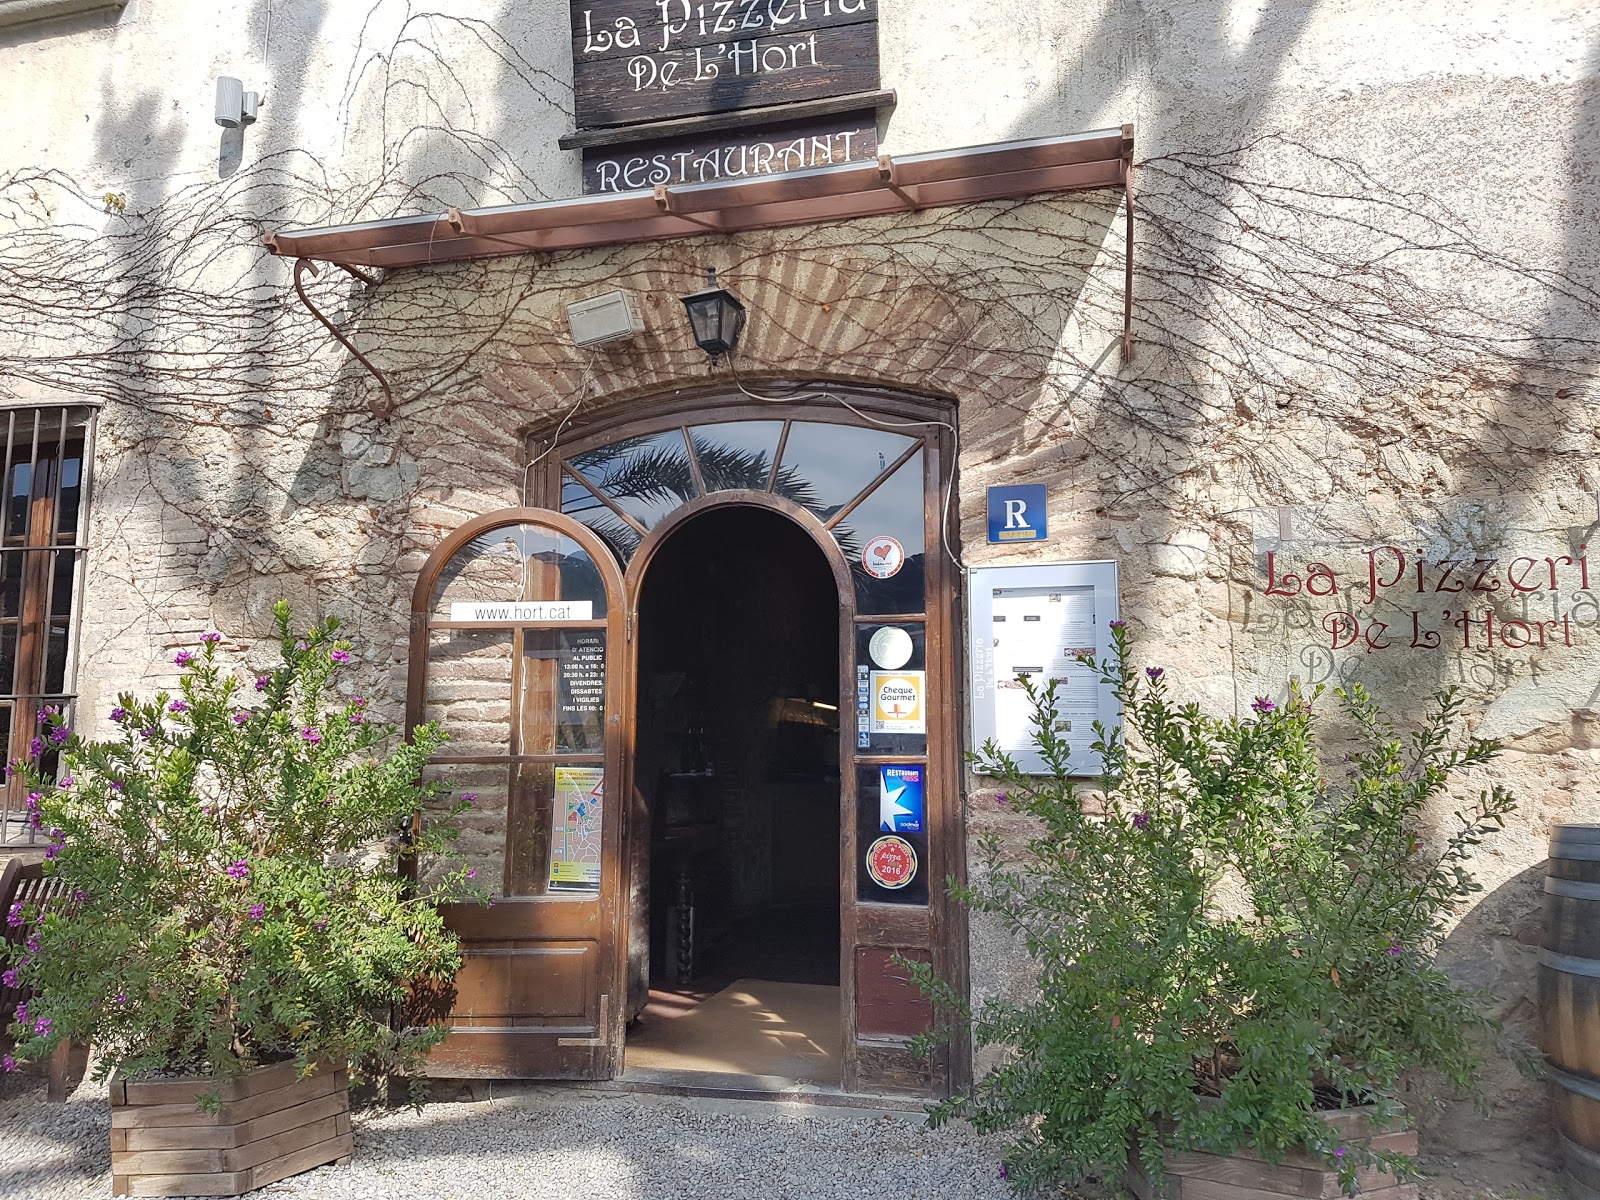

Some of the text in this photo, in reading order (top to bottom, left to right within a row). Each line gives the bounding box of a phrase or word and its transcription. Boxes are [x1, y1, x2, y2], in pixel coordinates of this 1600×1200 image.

[583, 10, 641, 53] La
[627, 31, 819, 92] De L'Hort
[596, 128, 861, 192] RESTAURANT
[1003, 499, 1031, 529] R
[1262, 543, 1591, 606] La Pizzeri
[474, 604, 572, 620] www.hort.cat
[1321, 608, 1573, 655] De L'Hort
[974, 638, 986, 699] La Pizzeria
[880, 693, 916, 701] Gourmet
[883, 686, 914, 695] Cheque
[881, 865, 901, 875] 2016
